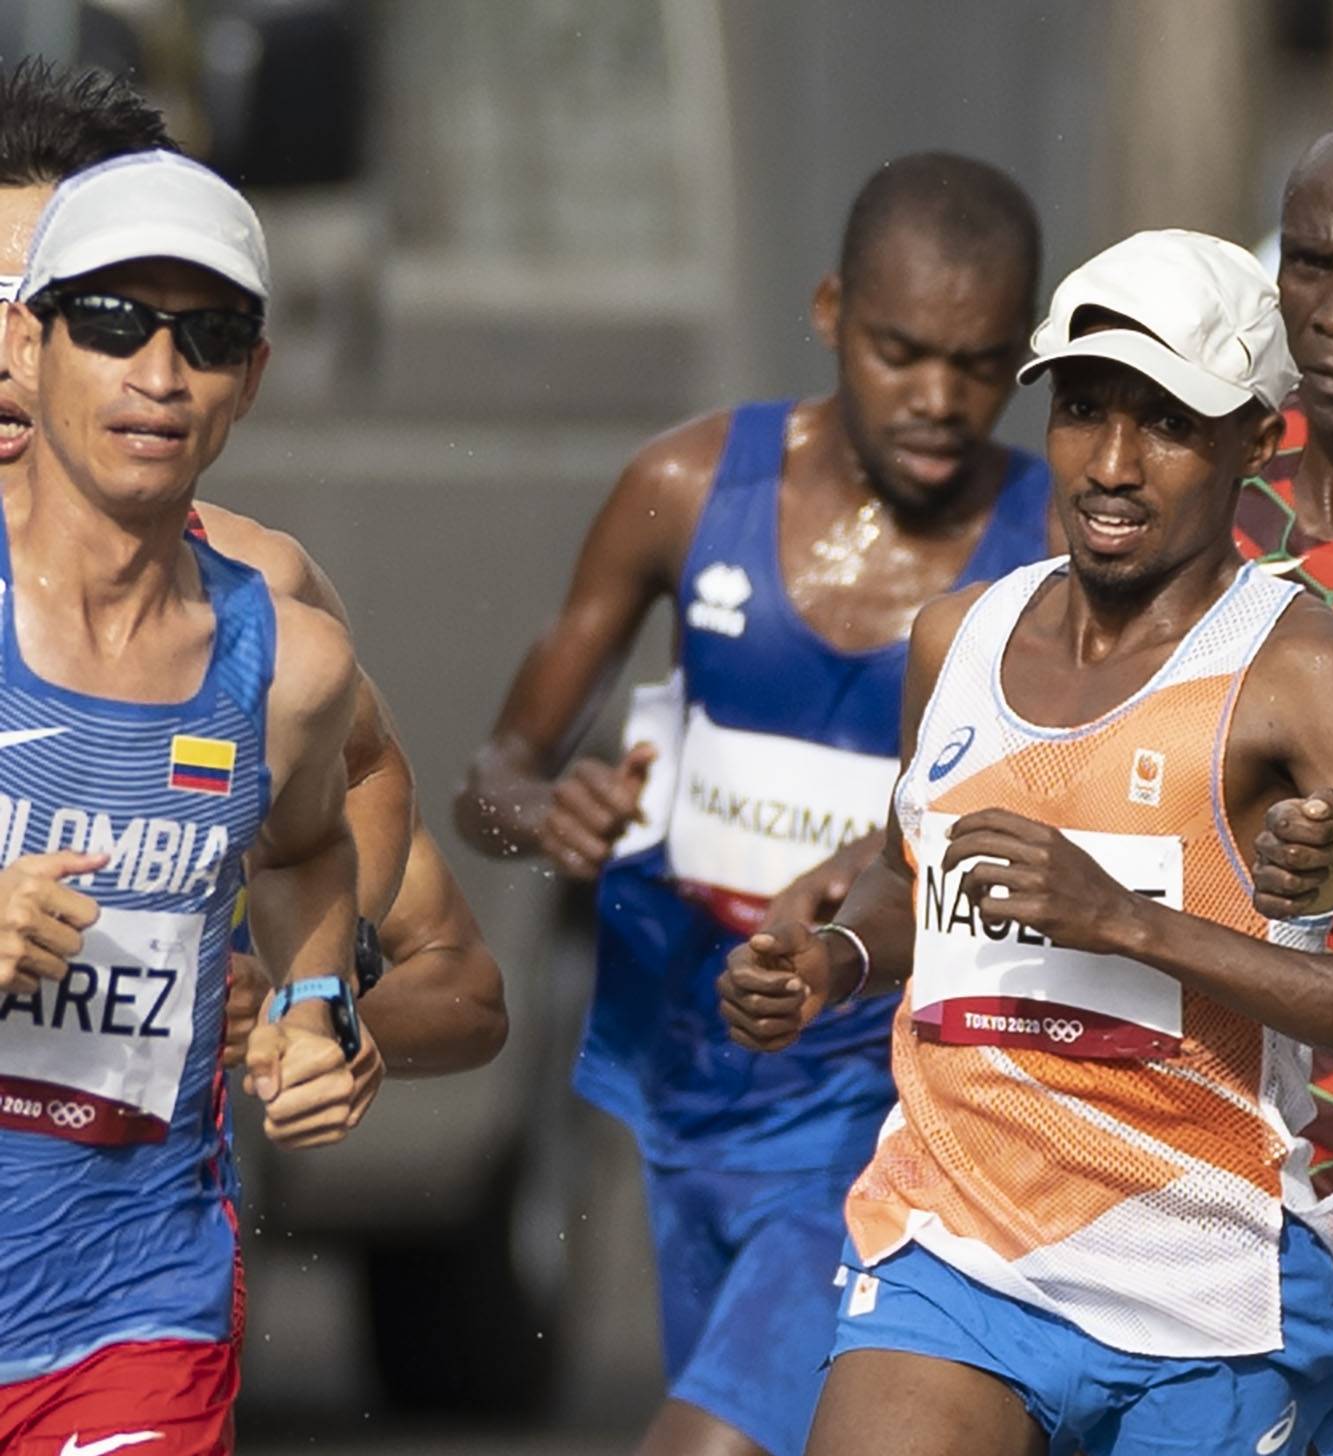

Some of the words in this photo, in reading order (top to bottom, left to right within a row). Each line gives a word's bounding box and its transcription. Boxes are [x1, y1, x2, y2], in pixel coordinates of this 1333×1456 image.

[689, 773, 884, 851] HAKIZIMA
[964, 1012, 1007, 1032] TOKYO
[1008, 1014, 1041, 1034] 2020
